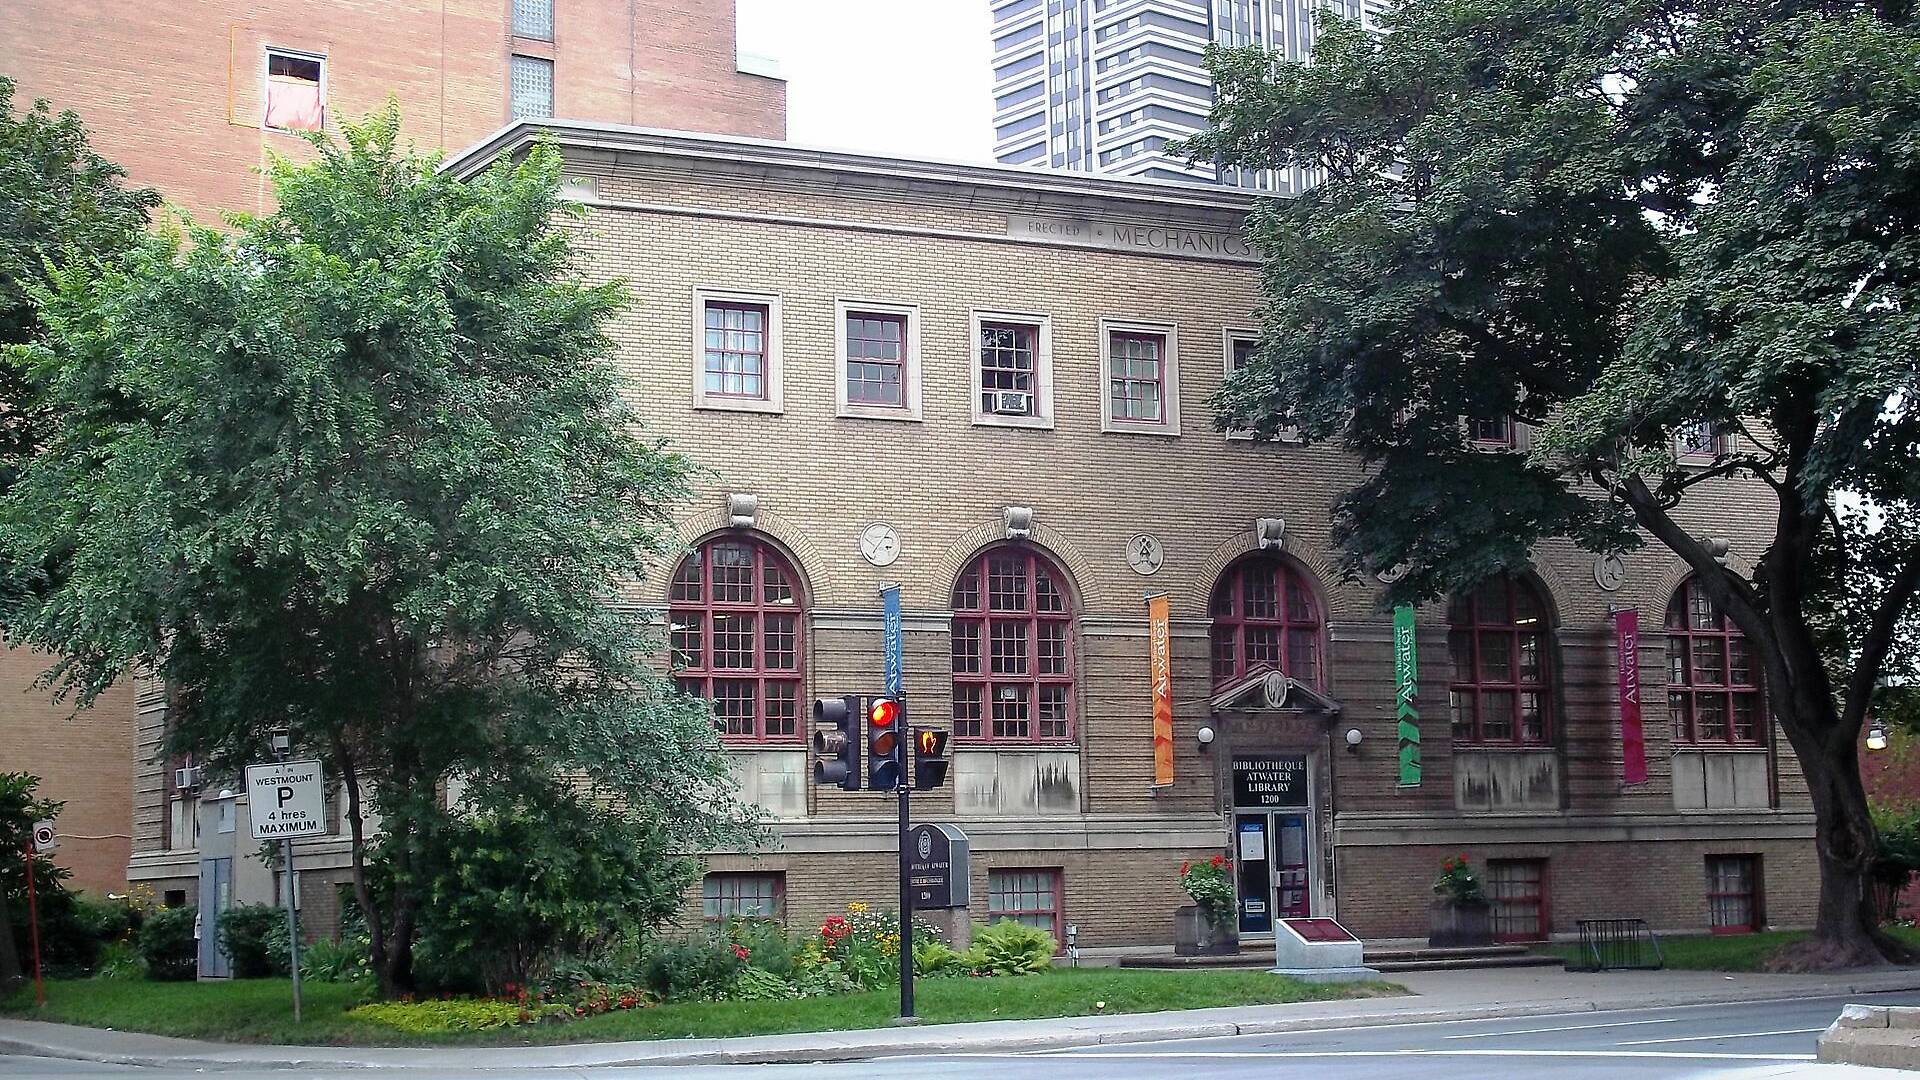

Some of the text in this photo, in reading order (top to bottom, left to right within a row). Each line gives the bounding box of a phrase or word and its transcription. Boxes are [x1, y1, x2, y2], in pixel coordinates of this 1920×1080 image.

[1028, 220, 1080, 236] ERECTED
[889, 612, 898, 694] Atwater
[1157, 618, 1167, 697] Atwater
[1401, 626, 1413, 703] Atwater
[1624, 631, 1637, 704] Atwater
[255, 774, 314, 787] WESTMOUNT
[1246, 771, 1292, 782] ATWATER
[1248, 783, 1290, 792] LIBRARY
[277, 786, 294, 809] P
[1261, 794, 1279, 804] 1200
[268, 811, 307, 821] 4 hres
[259, 821, 317, 834] MAXIMUM
